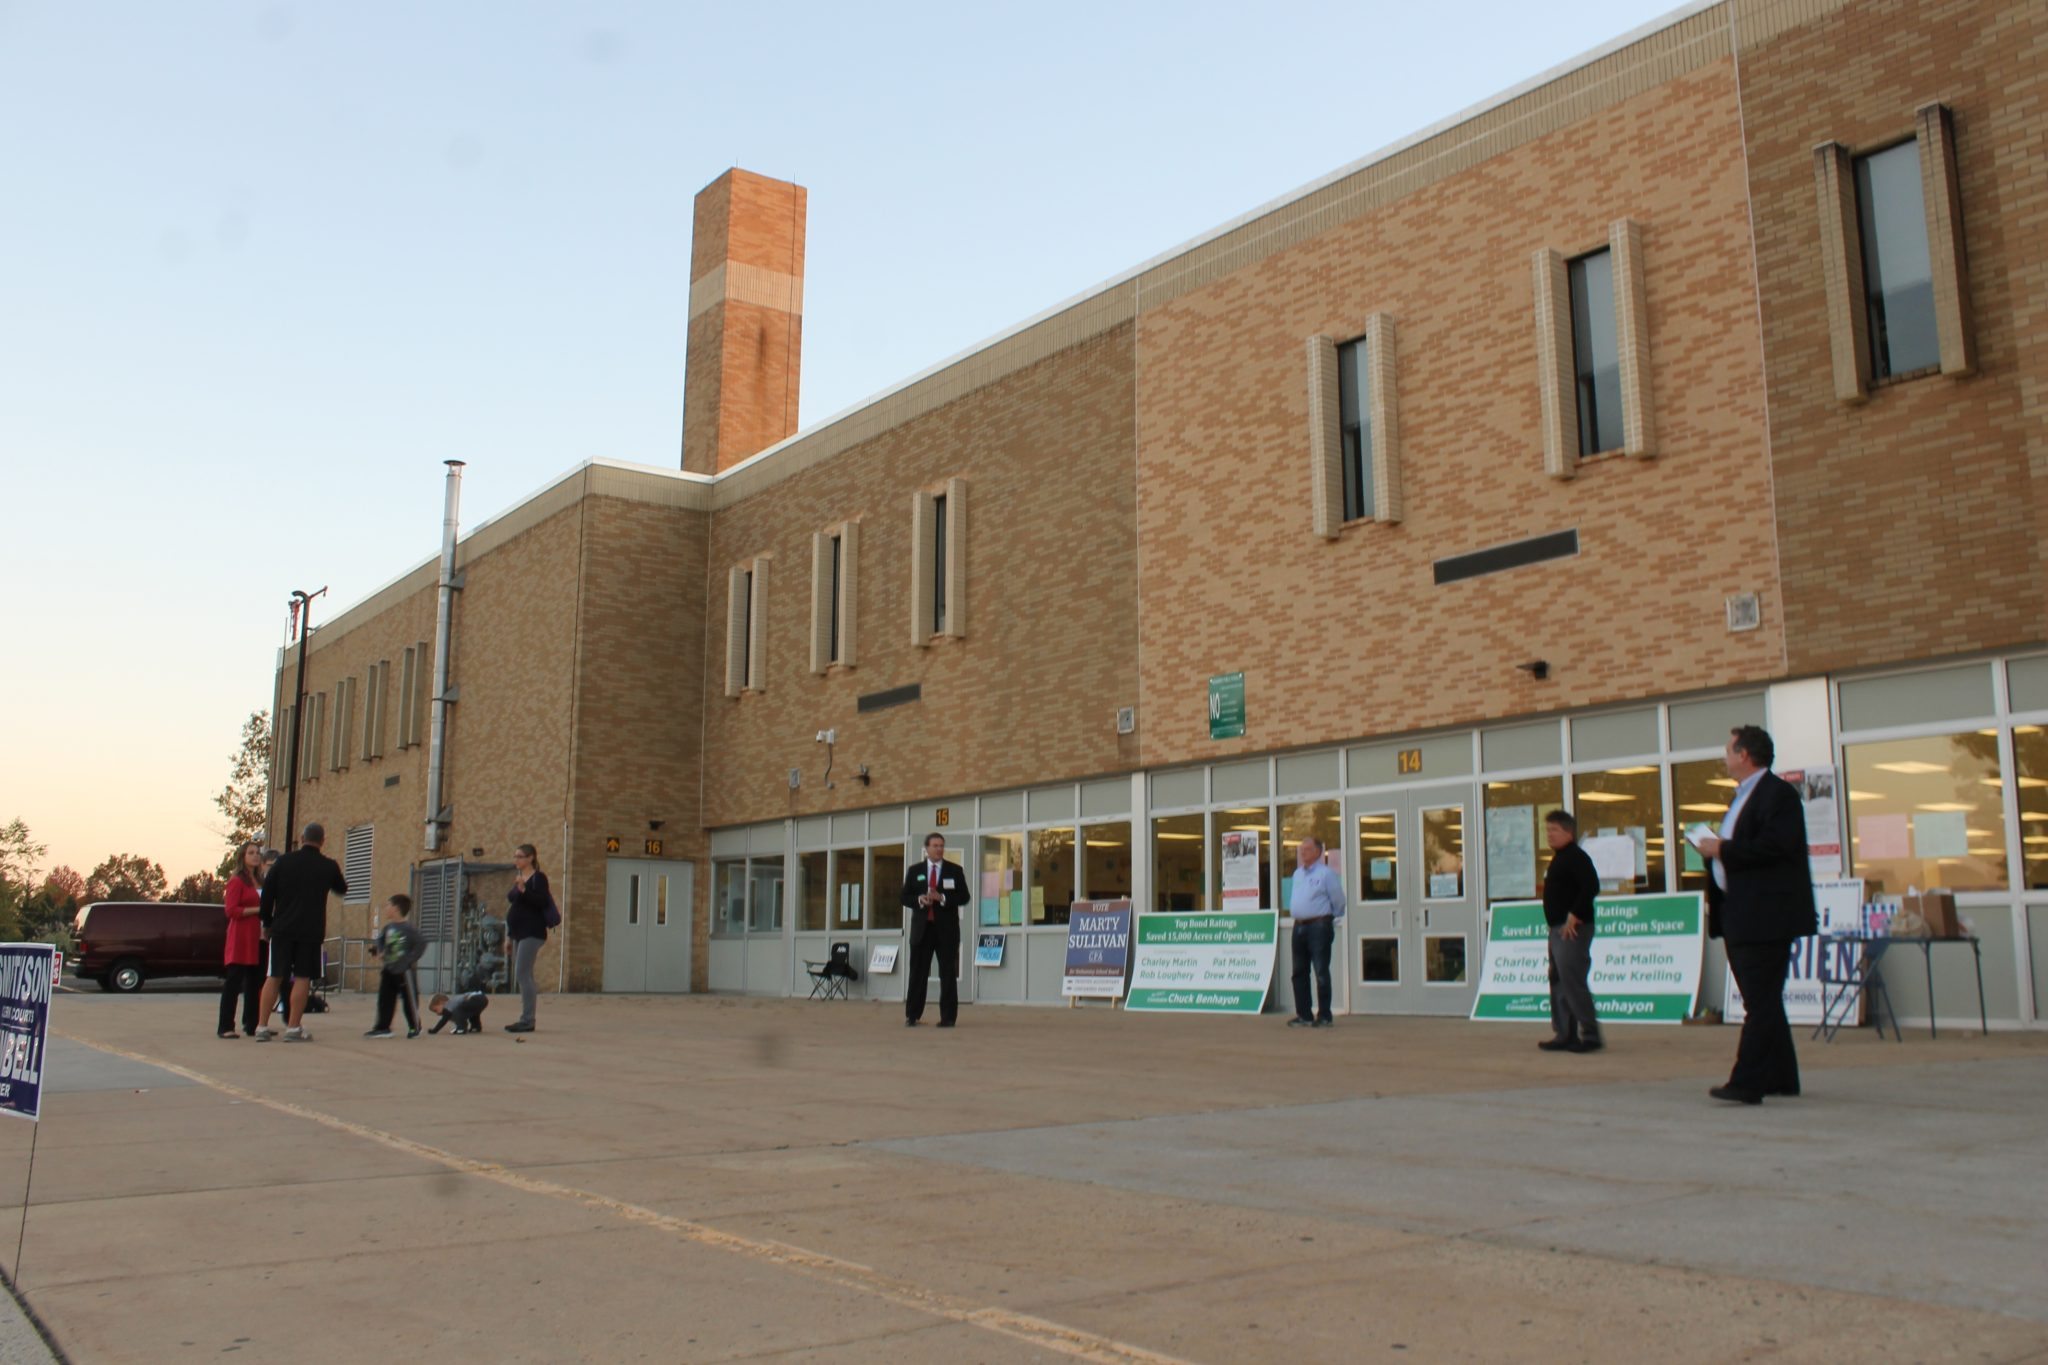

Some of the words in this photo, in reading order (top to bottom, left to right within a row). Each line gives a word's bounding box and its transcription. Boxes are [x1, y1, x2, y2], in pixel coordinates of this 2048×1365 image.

[1209, 692, 1220, 721] NO
[1400, 751, 1421, 772] 14
[937, 809, 949, 826] 15
[646, 840, 661, 854] 16
[1092, 903, 1110, 912] VOTE
[1596, 905, 1639, 919] Ratings
[1079, 917, 1120, 931] MARTY
[1175, 918, 1189, 930] Top
[1190, 918, 1208, 928] Bond
[1209, 918, 1238, 930] Ratings
[1502, 925, 1532, 937] Saved
[1604, 920, 1617, 933] of
[1618, 920, 1648, 935] Open
[1650, 919, 1685, 934] Space
[1068, 934, 1126, 948] SULLIVAN
[1146, 931, 1167, 941] Saved
[1168, 931, 1192, 942] 15,000
[1193, 931, 1213, 941] Acres
[1214, 931, 1222, 941] of
[1222, 931, 1243, 943] Open
[1243, 930, 1266, 942] Space
[1141, 957, 1171, 968] Charley
[1172, 957, 1198, 967] Martin
[1213, 957, 1227, 967] Pat
[1229, 957, 1257, 967] Mallon
[1494, 956, 1540, 969] Charley
[1605, 954, 1626, 966] Pat
[1630, 953, 1674, 965] Mallon
[1140, 970, 1156, 980] Rob
[1157, 970, 1194, 982] Loughery
[1204, 970, 1226, 981] Drew
[1493, 972, 1517, 984] Rob
[1519, 972, 1550, 985] Loug
[1593, 970, 1627, 982] Drew
[1168, 992, 1195, 1005] Chuck
[1196, 992, 1240, 1007] Benhayon
[1783, 992, 1818, 1002] SCHOOL
[1594, 999, 1655, 1014] enhayon
